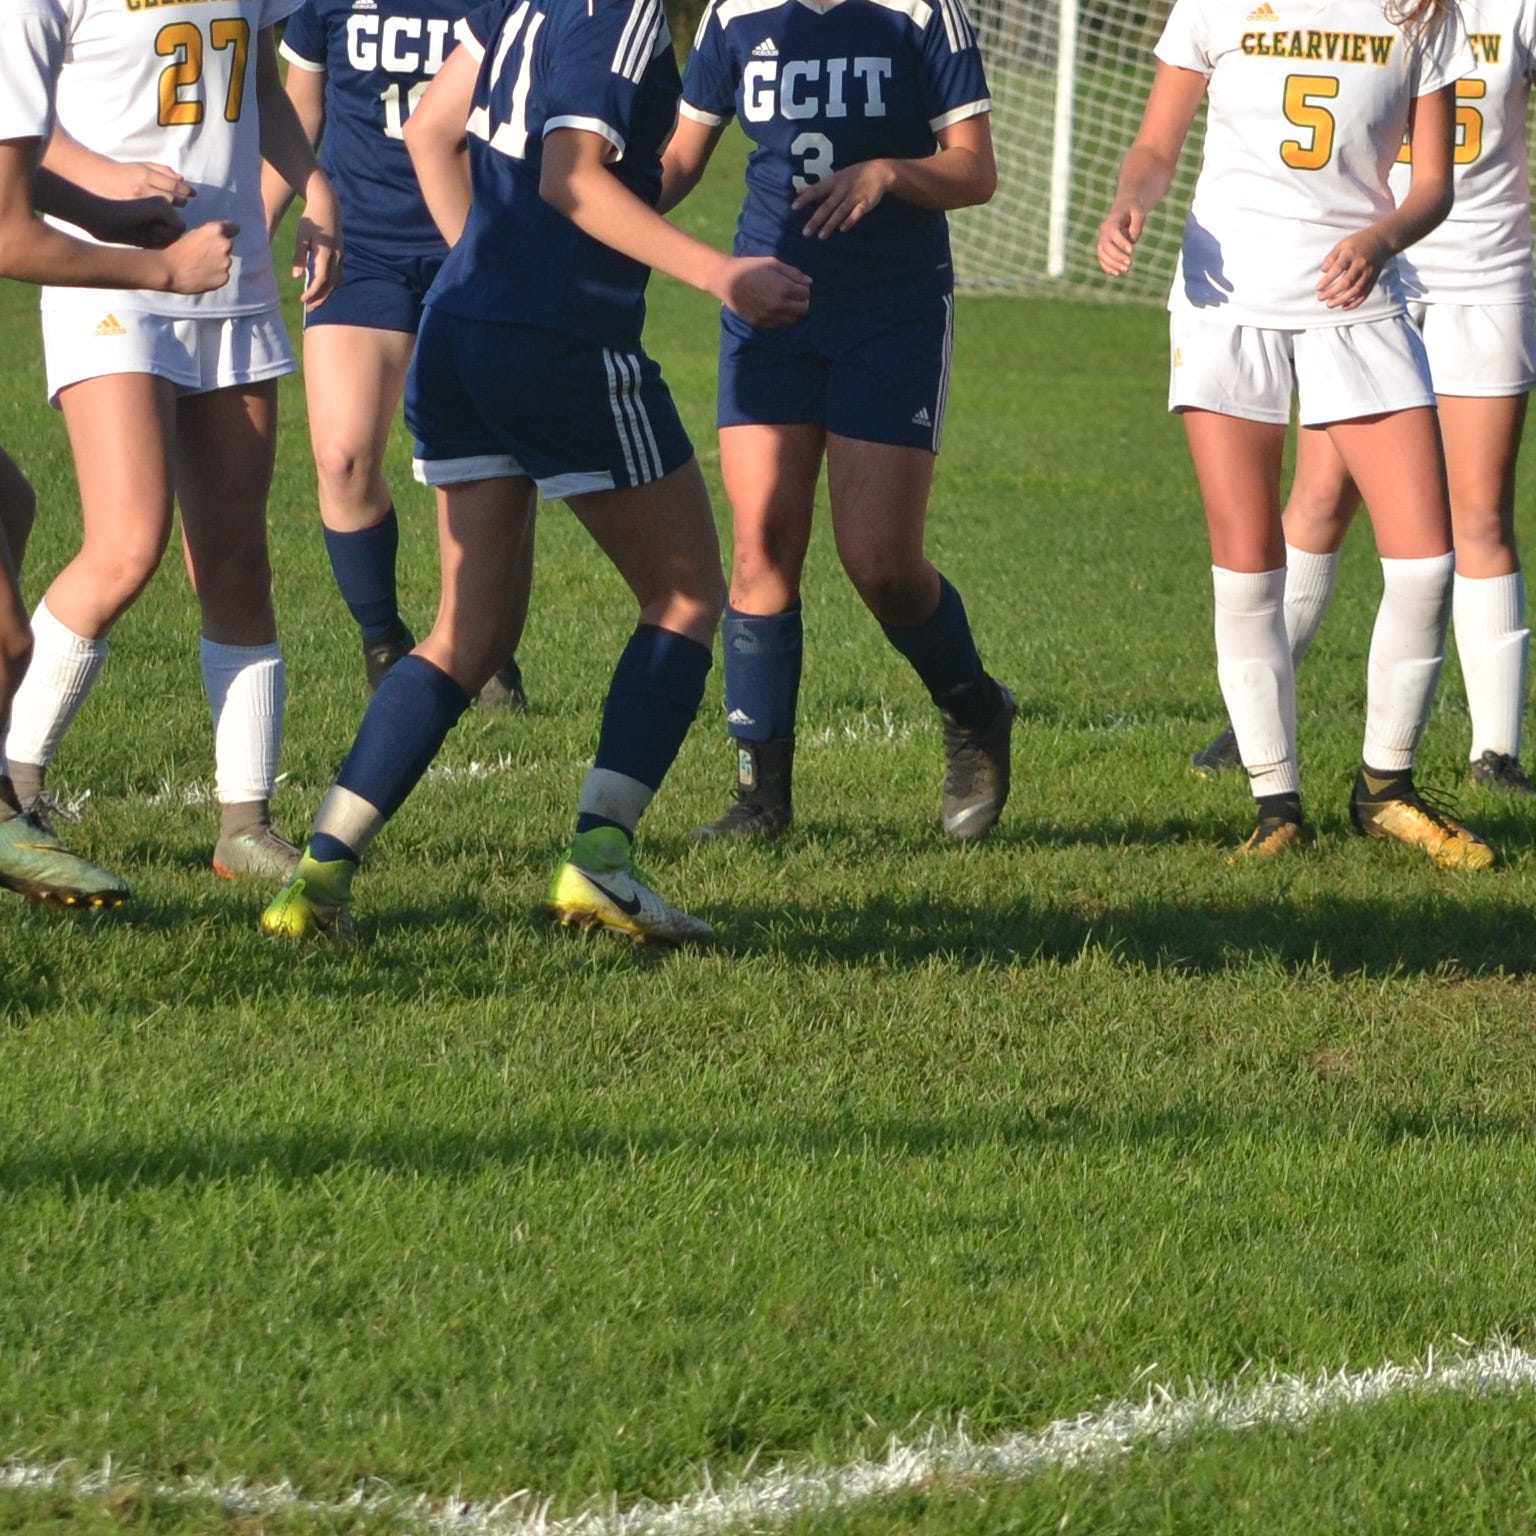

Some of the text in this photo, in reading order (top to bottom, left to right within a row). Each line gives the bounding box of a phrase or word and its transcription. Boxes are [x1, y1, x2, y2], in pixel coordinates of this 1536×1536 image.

[154, 17, 251, 127] 27
[347, 13, 464, 75] GCI
[1240, 29, 1395, 66] CLEARVIEW
[380, 81, 432, 141] 1
[465, 0, 546, 160] 11
[743, 57, 893, 123] GCIT
[1279, 74, 1340, 170] 5
[790, 132, 835, 195] 3
